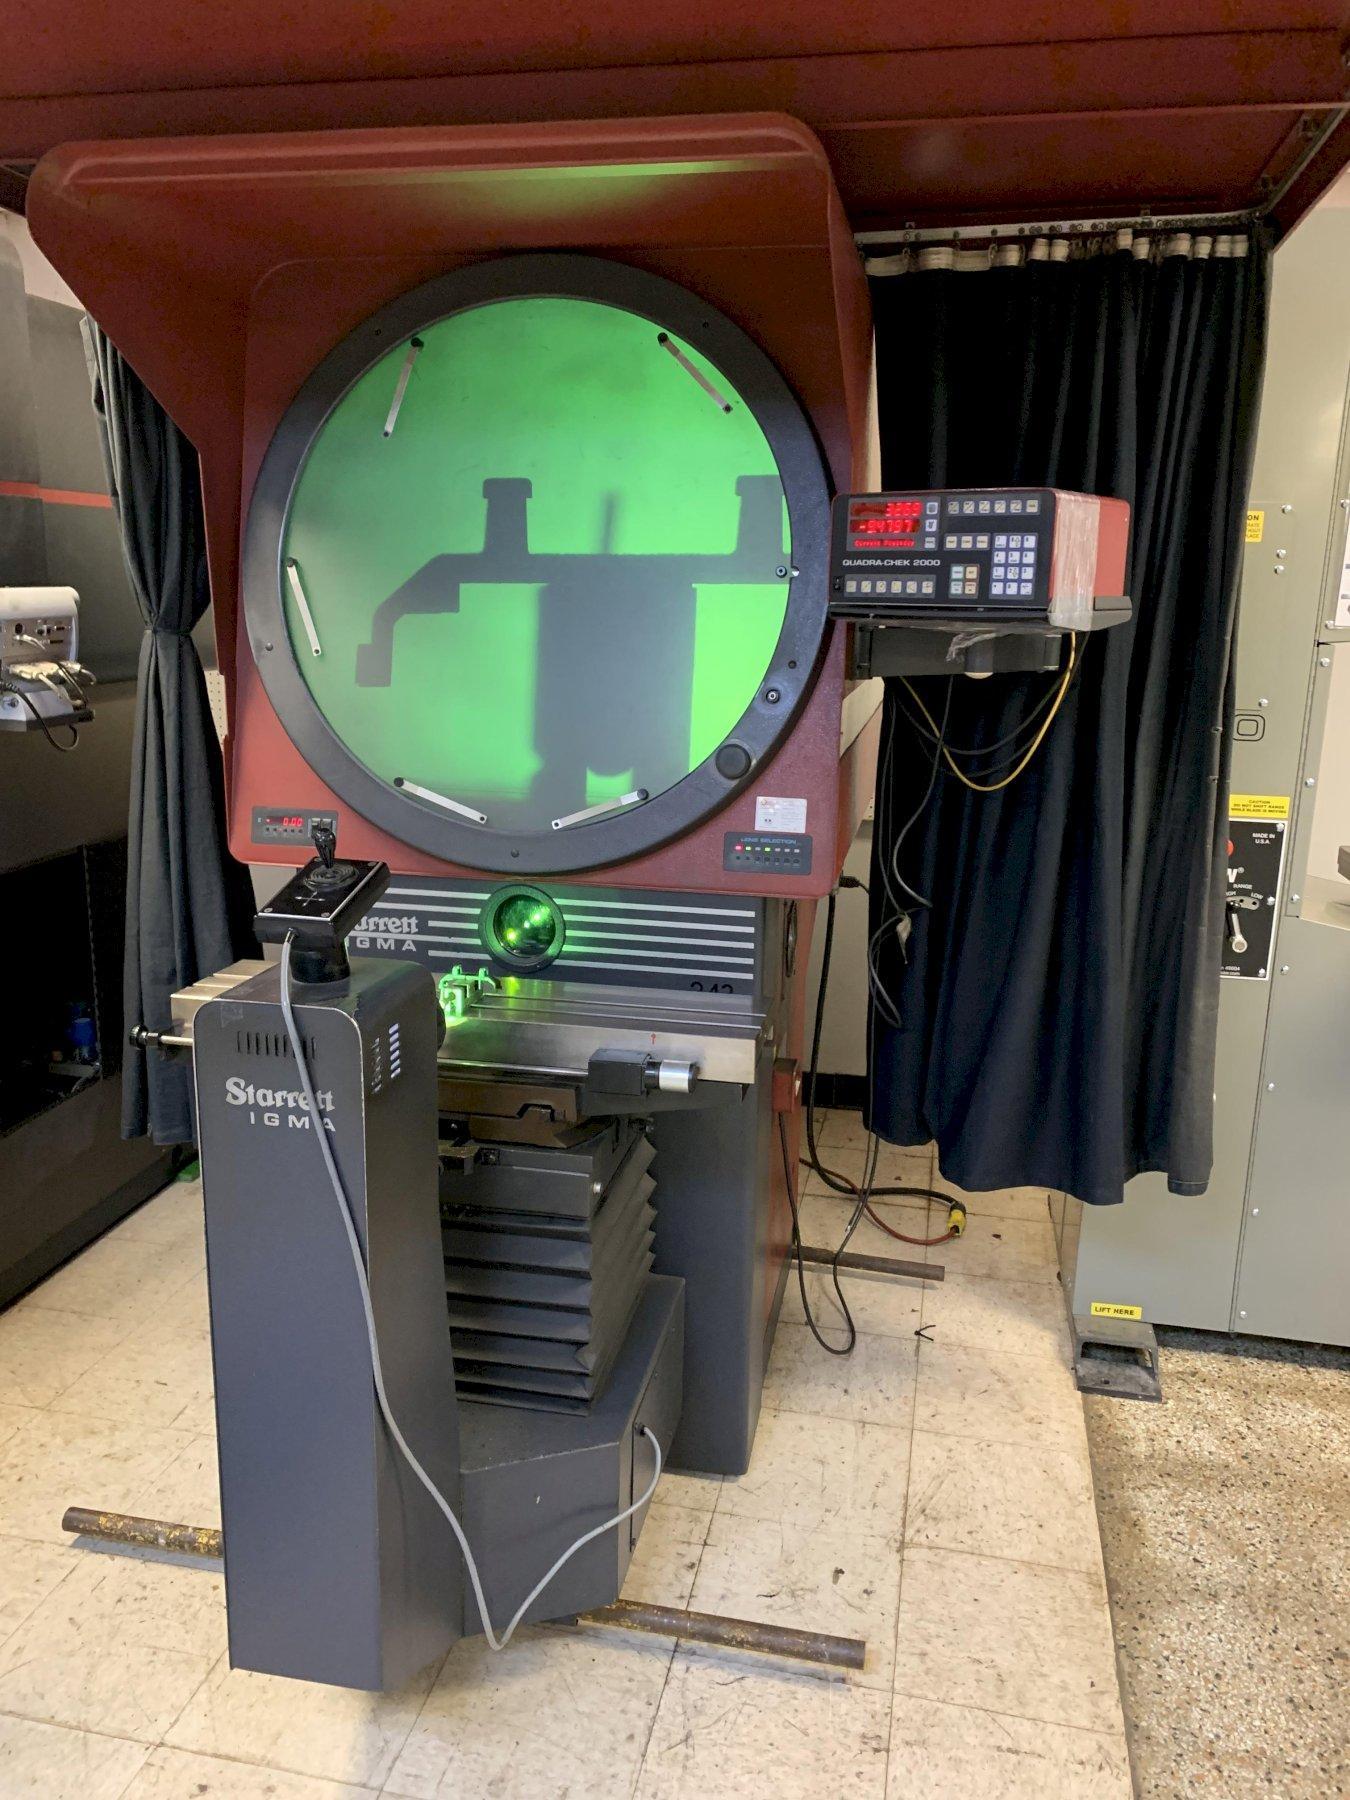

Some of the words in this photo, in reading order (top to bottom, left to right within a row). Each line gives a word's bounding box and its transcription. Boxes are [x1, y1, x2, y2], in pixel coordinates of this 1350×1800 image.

[842, 559, 911, 567] QUADRA-CHEK
[913, 559, 941, 567] 2000
[354, 915, 418, 934] arrett
[225, 1076, 336, 1112] Starrett
[1094, 1306, 1111, 1314] LIFT
[1113, 1308, 1135, 1316] HERE
